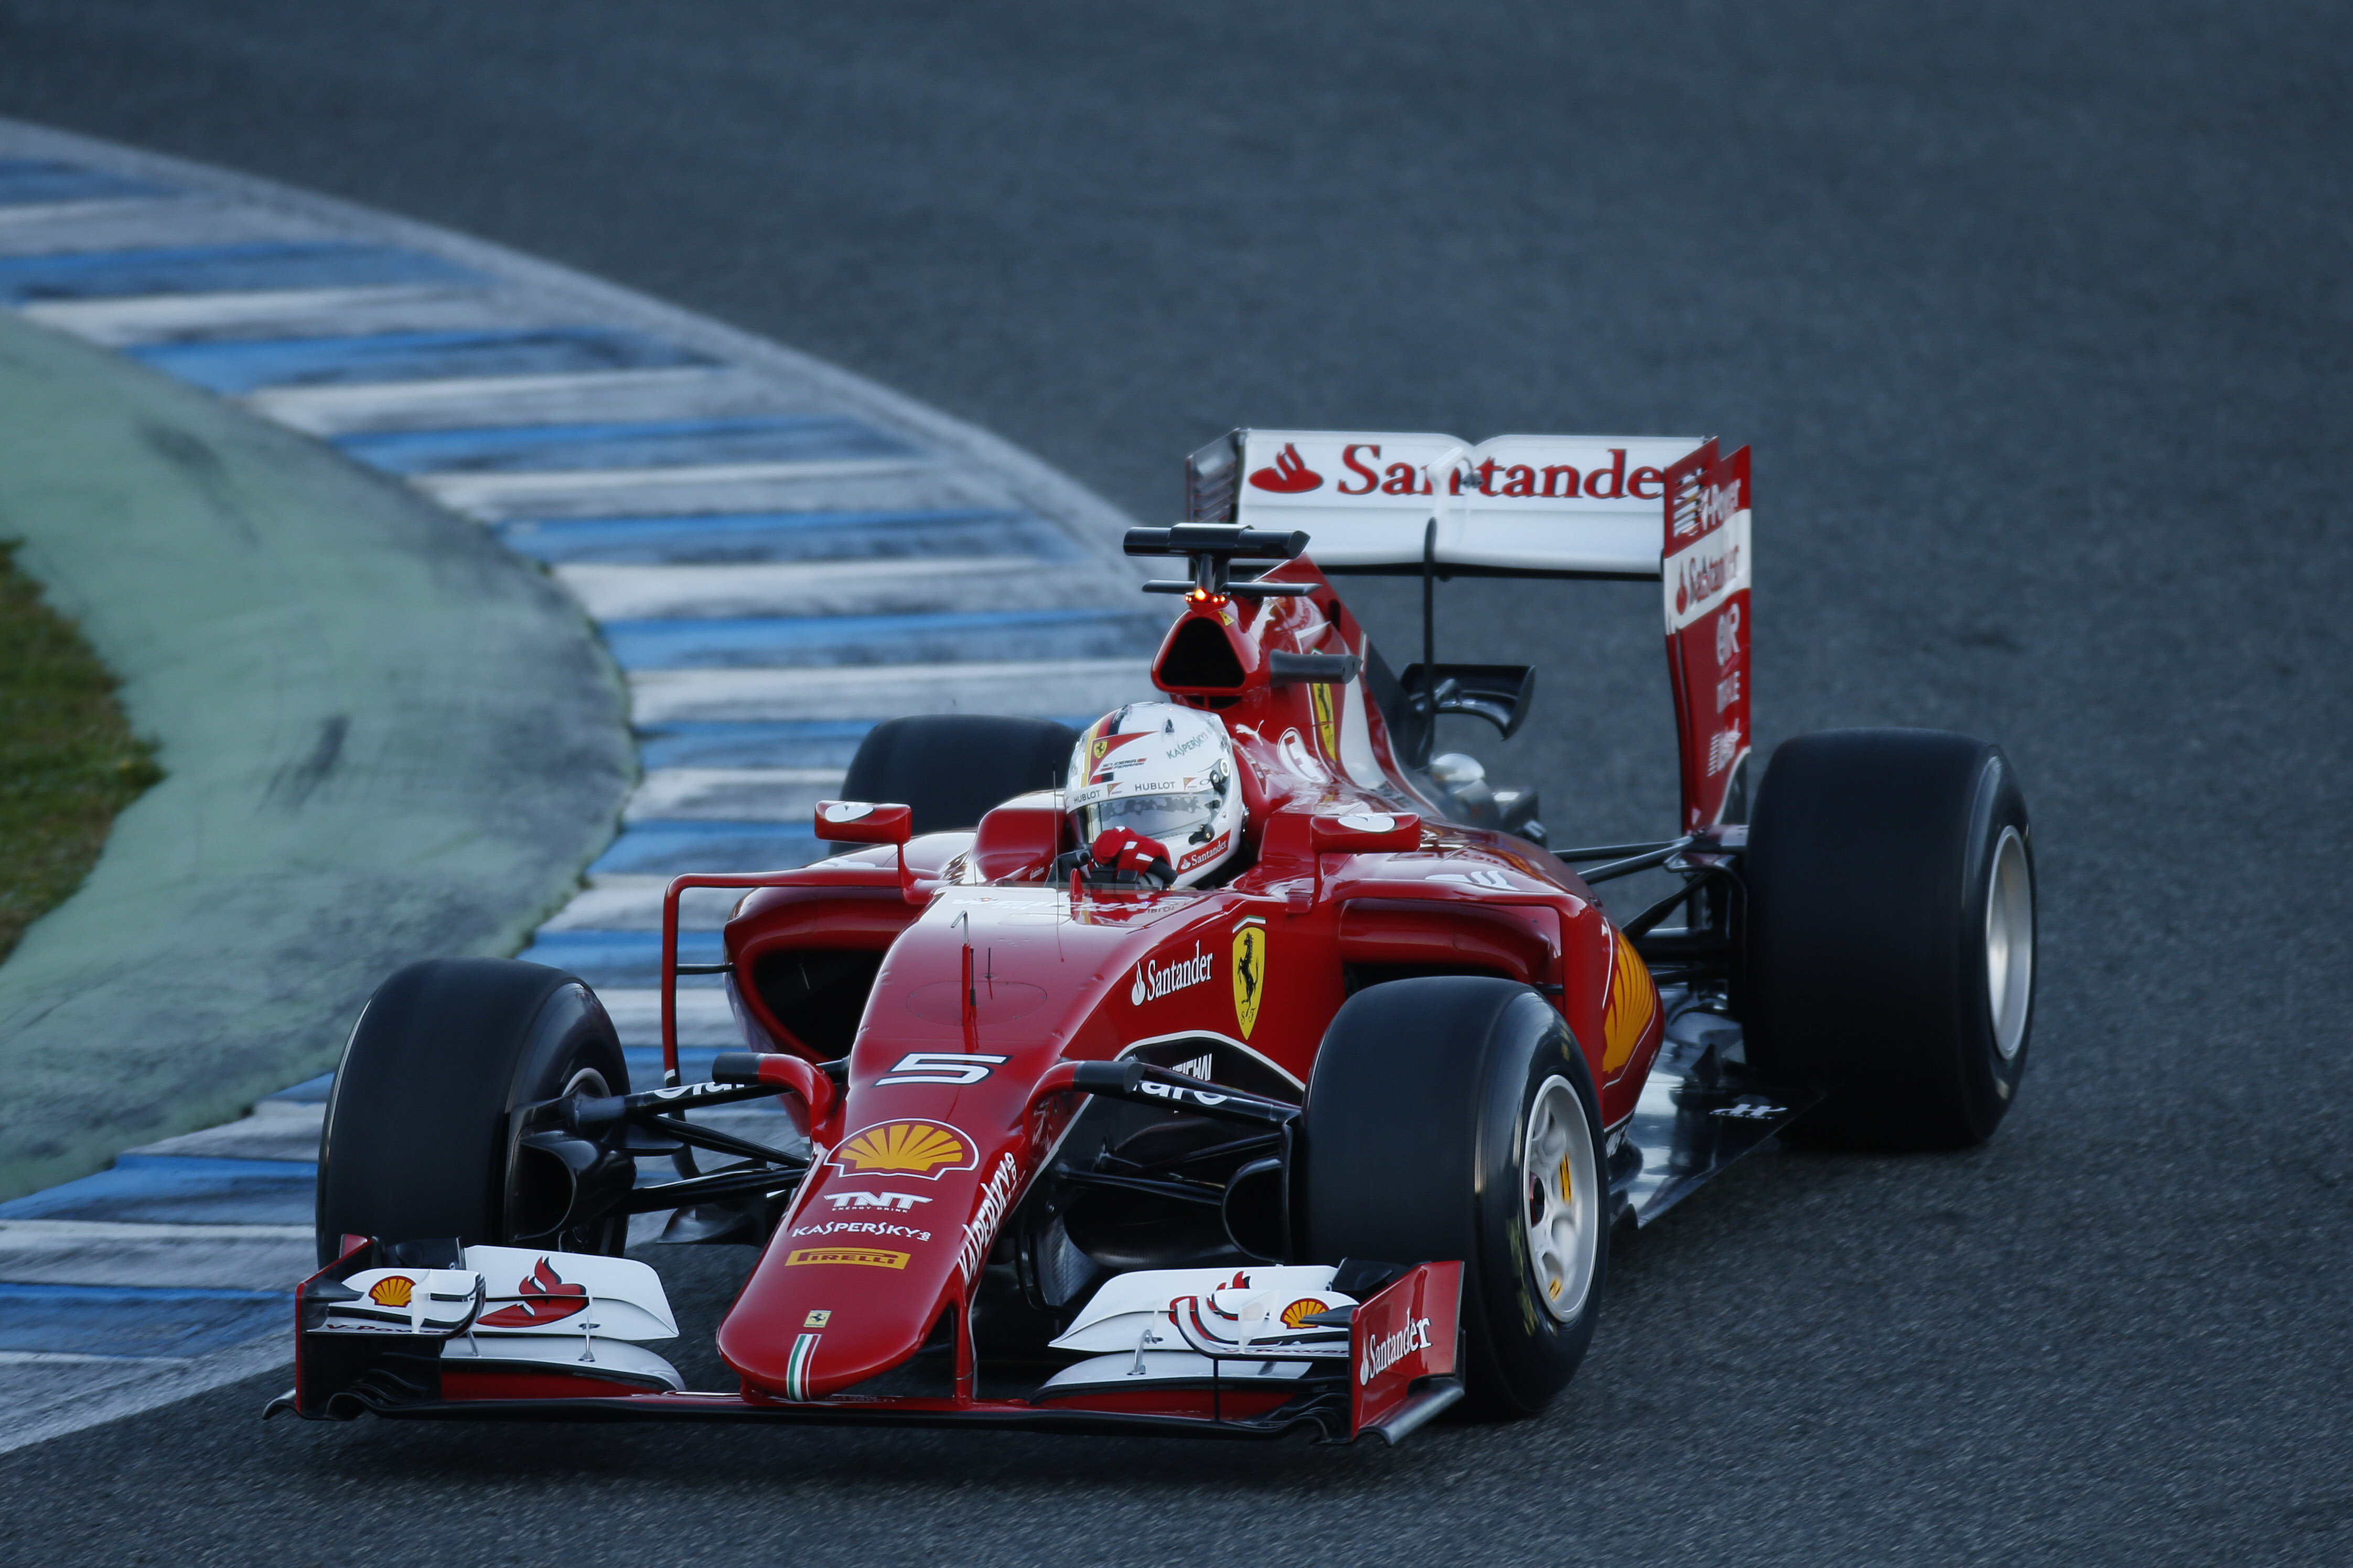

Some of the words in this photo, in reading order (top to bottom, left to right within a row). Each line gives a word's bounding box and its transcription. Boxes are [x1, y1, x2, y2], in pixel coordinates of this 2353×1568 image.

[1337, 444, 1664, 500] Santande
[1135, 781, 1176, 791] HUBLOT
[1073, 790, 1101, 804] HUBLOT
[1191, 840, 1227, 866] Santander
[1147, 939, 1213, 1001] Santander
[873, 1053, 1010, 1087] 5
[823, 1192, 933, 1209] TNT
[791, 1221, 920, 1238] KASPERSKY
[797, 1251, 899, 1264] PIRELLI
[1369, 1306, 1433, 1379] Santander
